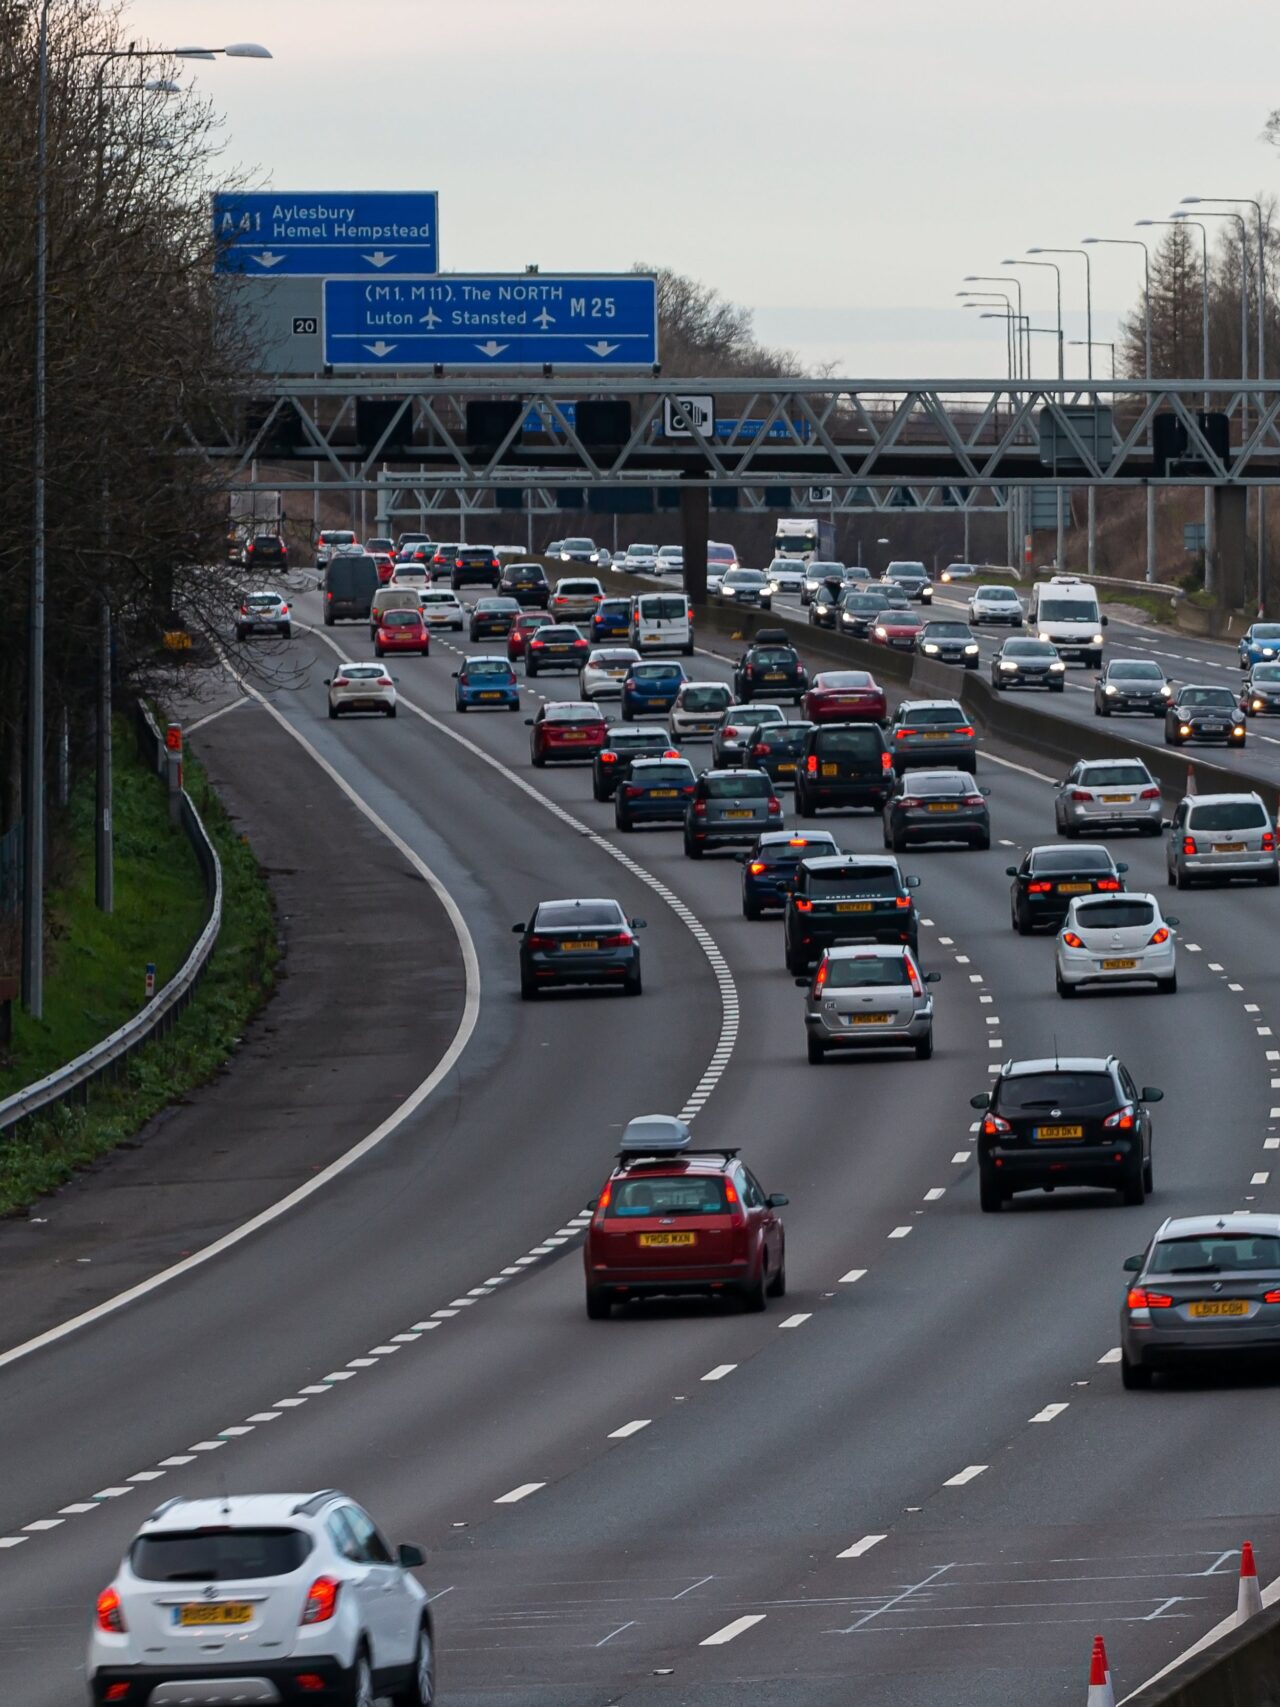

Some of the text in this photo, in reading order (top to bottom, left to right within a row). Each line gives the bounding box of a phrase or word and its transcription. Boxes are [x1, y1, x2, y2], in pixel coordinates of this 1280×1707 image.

[273, 205, 355, 221] Aylesbury
[274, 223, 429, 239] Hemel Hempstead
[462, 286, 491, 300] The
[499, 286, 563, 300] NORTH
[570, 298, 616, 317] M25
[366, 310, 527, 325] Luton Stansted
[296, 320, 315, 333] 20
